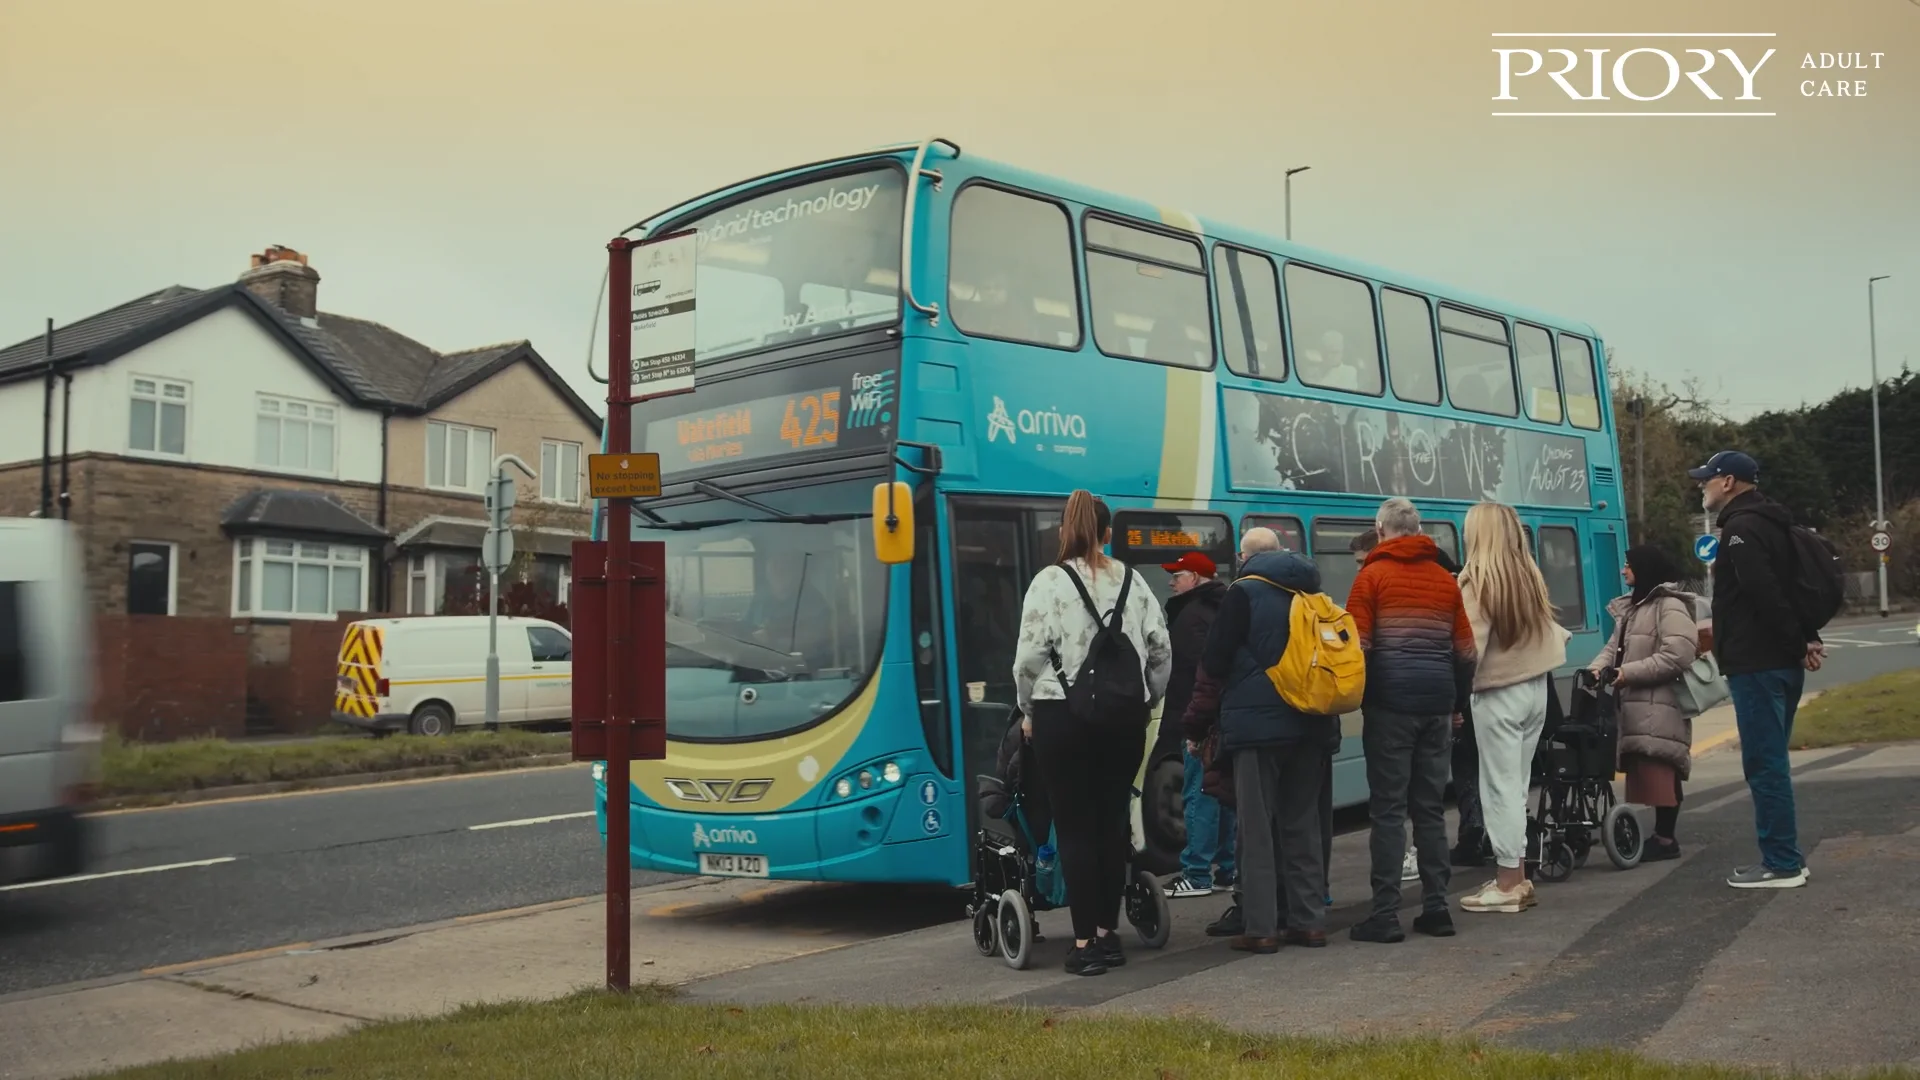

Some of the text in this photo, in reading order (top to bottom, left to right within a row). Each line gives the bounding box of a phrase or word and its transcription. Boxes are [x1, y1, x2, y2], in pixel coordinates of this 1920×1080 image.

[753, 184, 880, 229] technology
[633, 306, 670, 320] Buses towards
[640, 360, 650, 368] Bus
[650, 358, 661, 366] Stop
[652, 371, 663, 379] Stop
[851, 371, 882, 391] free
[850, 390, 882, 411] WiFi
[780, 391, 841, 448] 425
[1017, 405, 1086, 439] arriva
[1291, 412, 1487, 495] CROW
[596, 471, 655, 481] No stopping
[1528, 457, 1585, 493] AUGUST 23
[595, 484, 656, 493] except buses
[1873, 537, 1889, 546] 30
[709, 825, 758, 844] arriva
